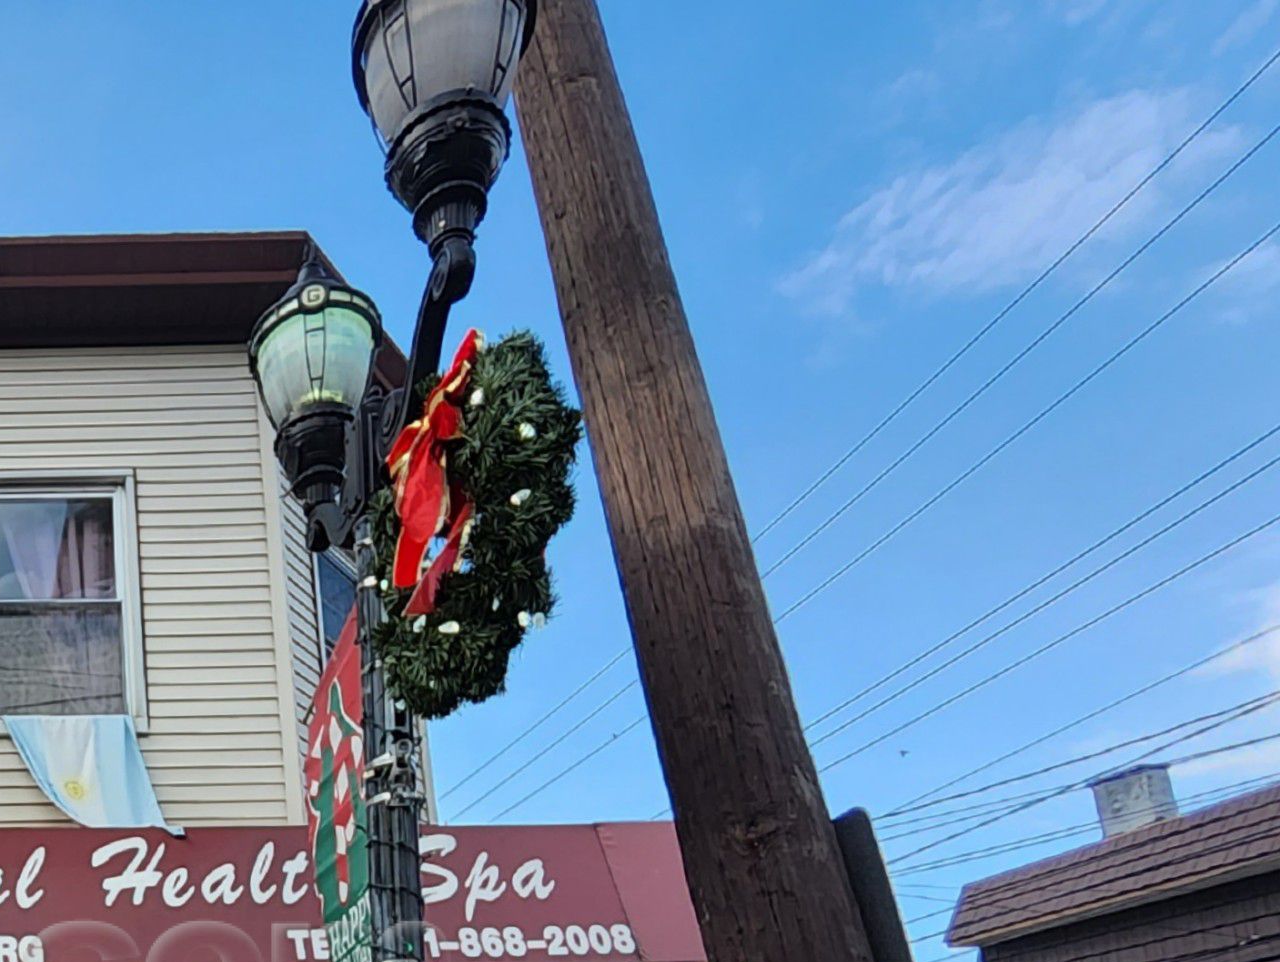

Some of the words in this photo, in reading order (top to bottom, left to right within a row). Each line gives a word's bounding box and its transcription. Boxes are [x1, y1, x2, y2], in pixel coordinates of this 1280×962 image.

[306, 288, 321, 303] G
[91, 836, 310, 908] Healt
[419, 833, 556, 923] Spa
[286, 928, 330, 961] TE
[423, 924, 636, 958] 1-868-2008
